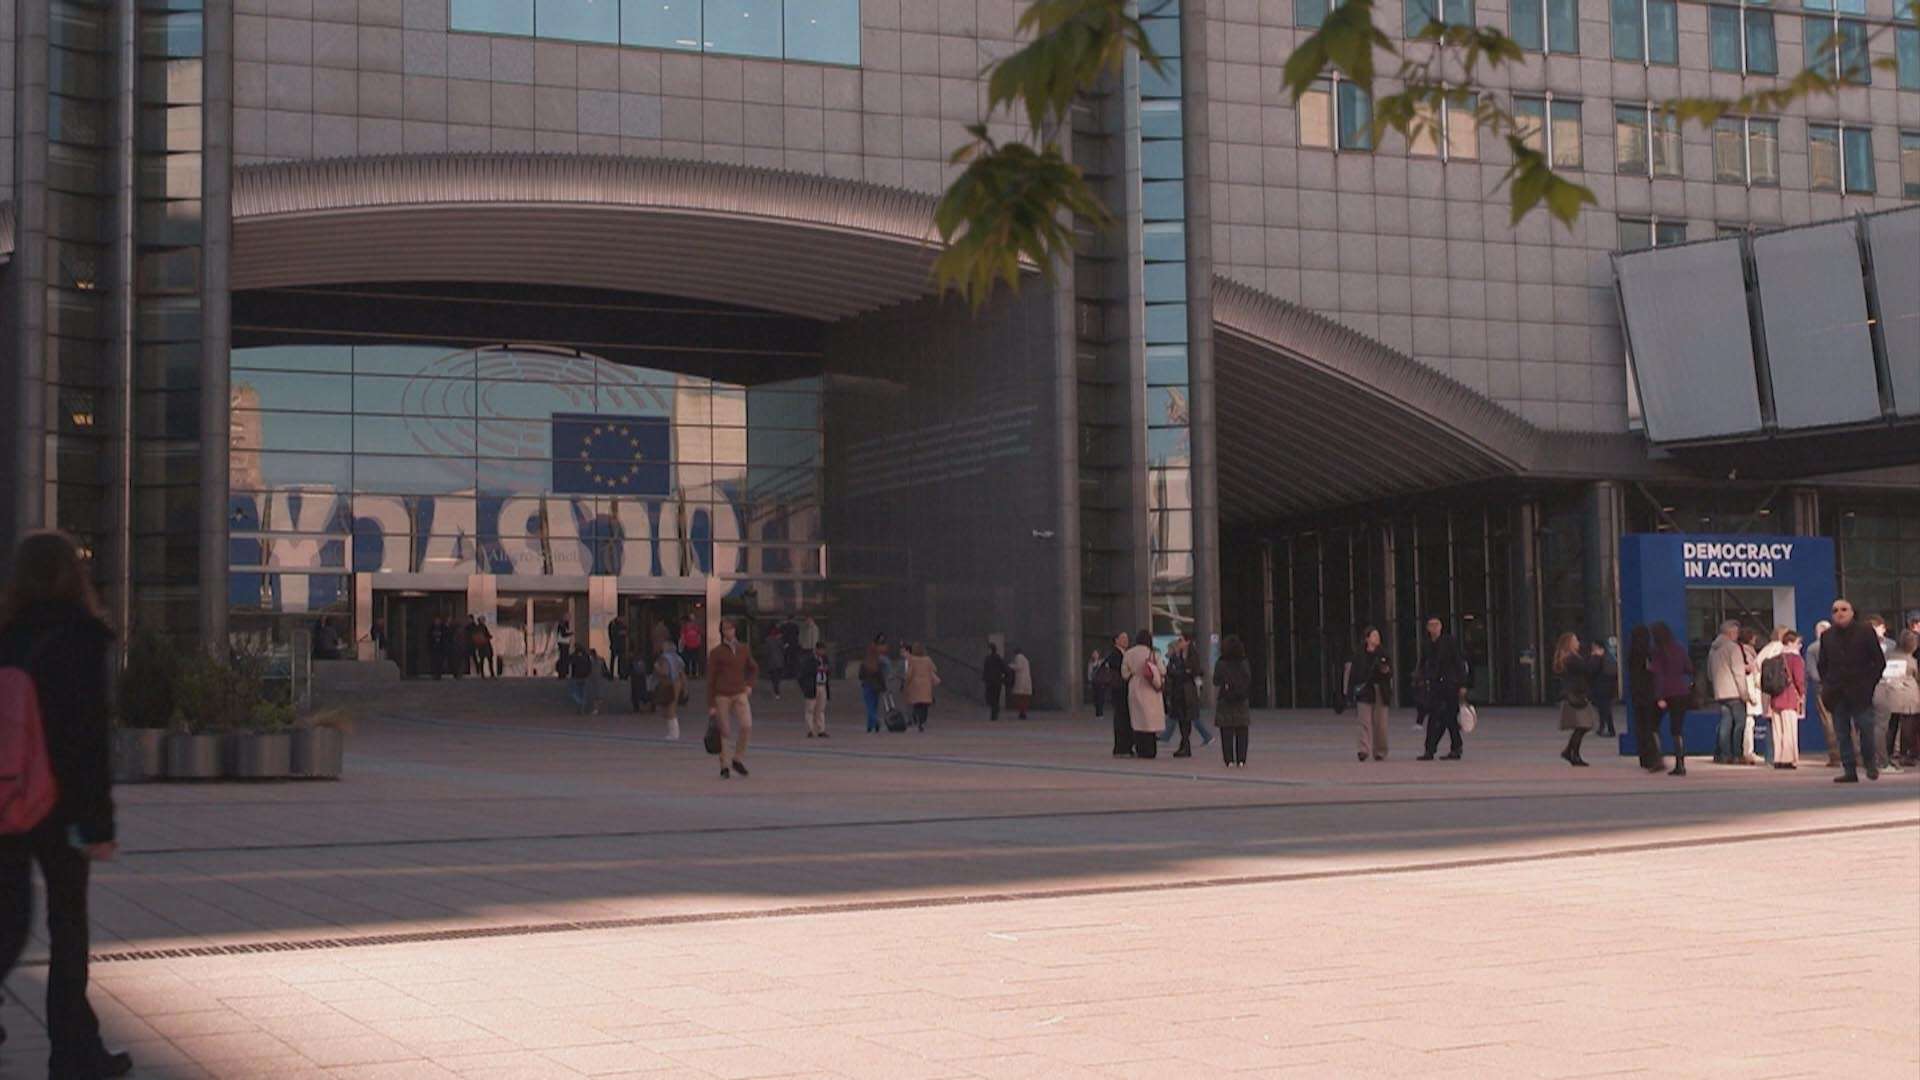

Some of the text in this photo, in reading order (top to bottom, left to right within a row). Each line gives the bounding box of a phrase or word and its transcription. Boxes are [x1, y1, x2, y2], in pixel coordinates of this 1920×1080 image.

[1683, 542, 1793, 560] DEMOCRACY
[1684, 561, 1773, 578] IN ACTION
